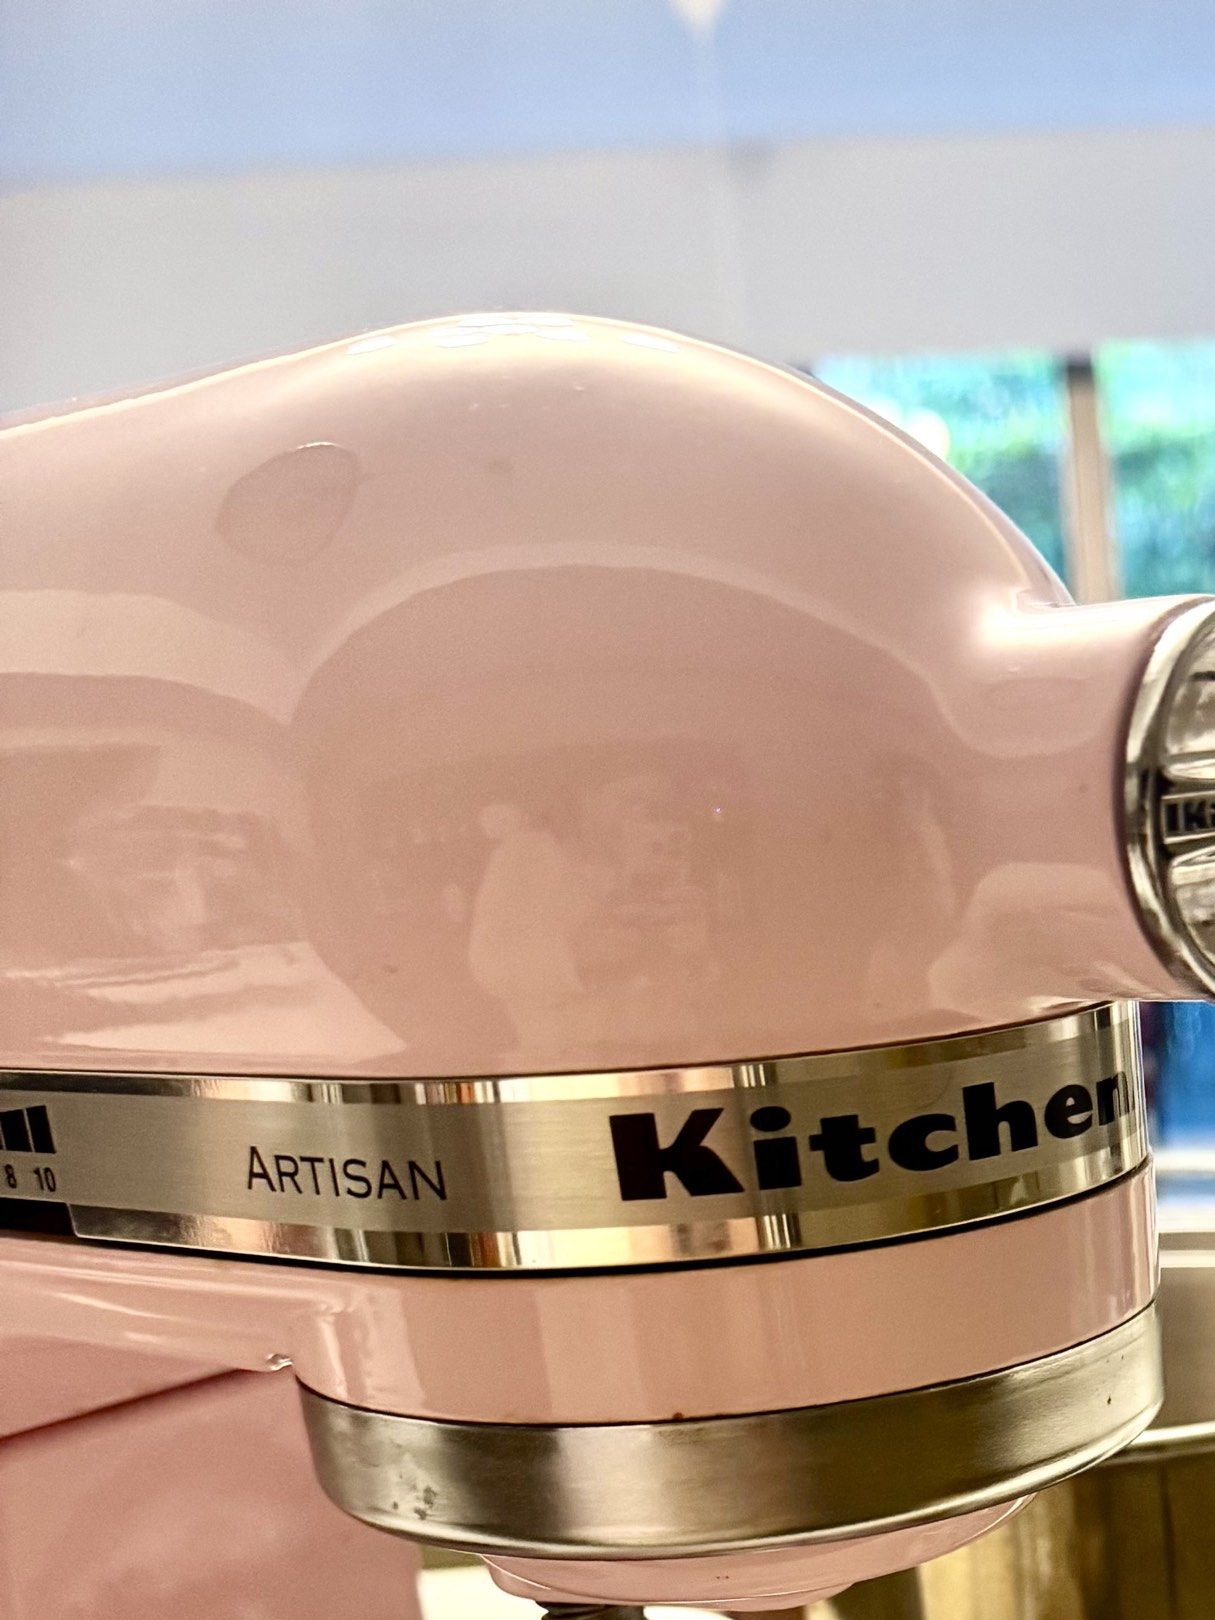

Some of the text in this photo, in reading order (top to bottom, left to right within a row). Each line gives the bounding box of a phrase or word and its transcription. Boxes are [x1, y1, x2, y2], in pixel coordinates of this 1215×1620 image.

[608, 1070, 1131, 1202] Kitchen
[4, 1163, 57, 1192] 8 10
[247, 1145, 447, 1201] ARTISAN
